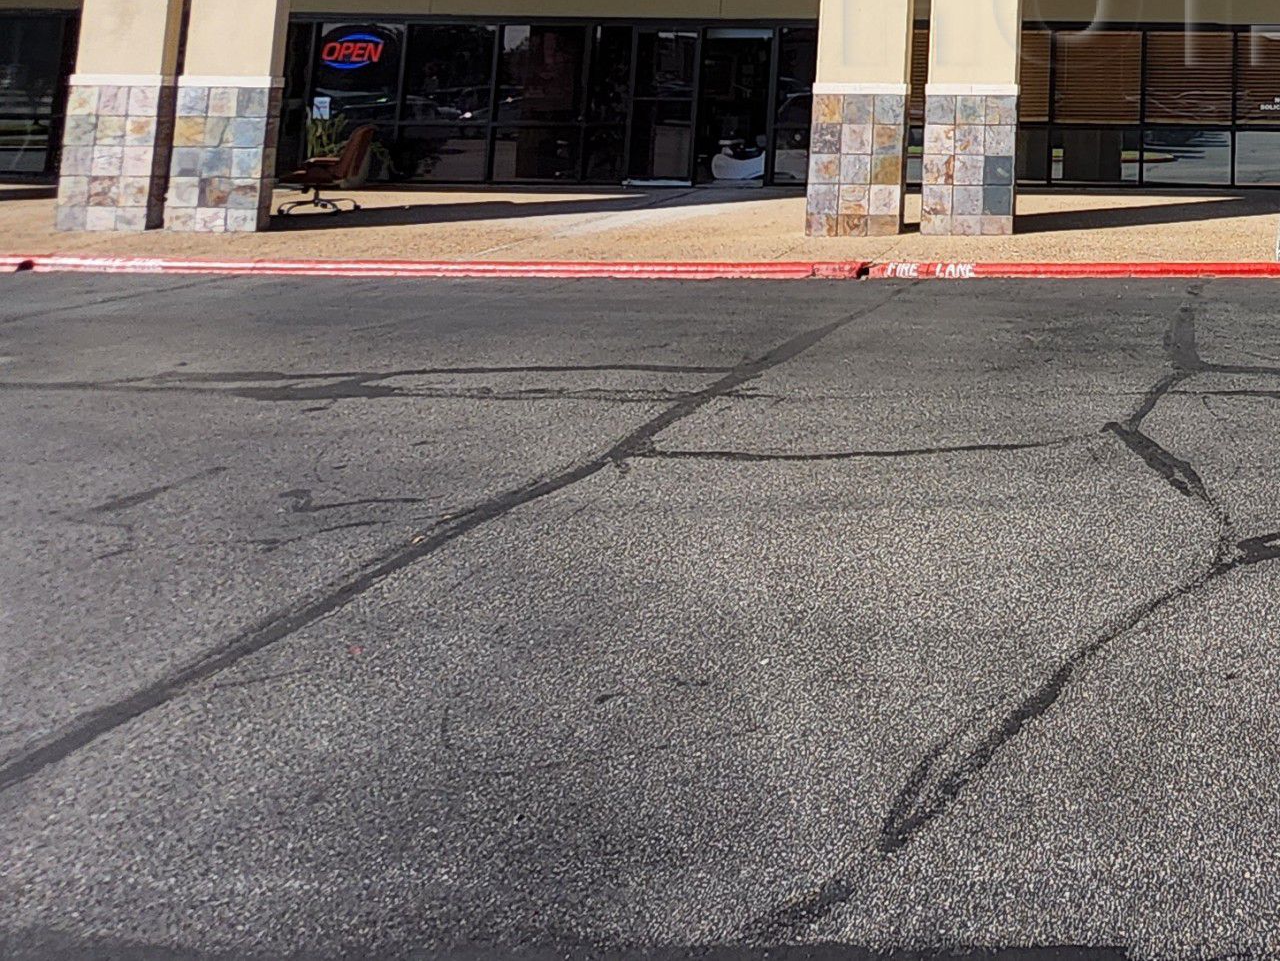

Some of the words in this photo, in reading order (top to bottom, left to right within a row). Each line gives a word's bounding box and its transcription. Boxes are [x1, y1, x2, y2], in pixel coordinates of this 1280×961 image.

[322, 42, 384, 62] OPEN
[887, 263, 918, 278] FIRE
[936, 263, 976, 278] LANE
